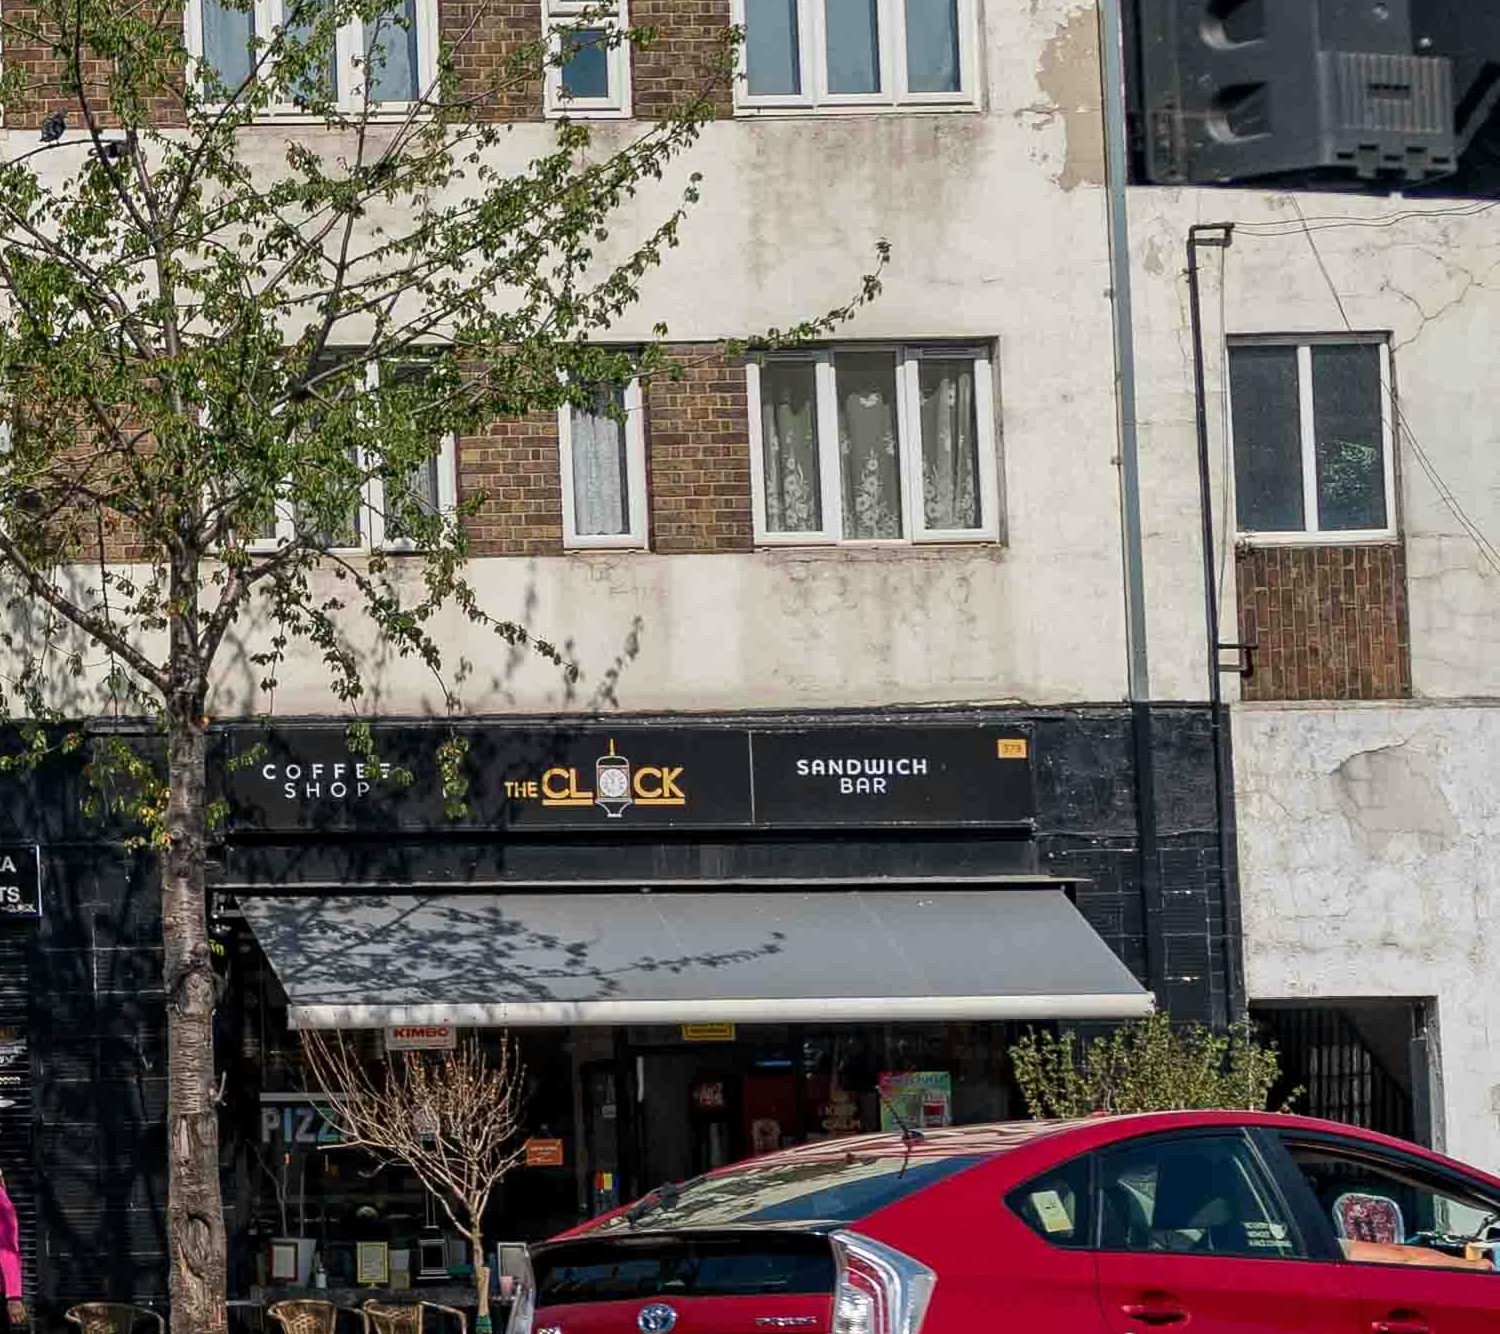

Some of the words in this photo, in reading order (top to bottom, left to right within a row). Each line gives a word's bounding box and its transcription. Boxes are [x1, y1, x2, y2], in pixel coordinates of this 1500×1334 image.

[796, 758, 927, 776] SANDWICH
[284, 781, 370, 799] SHOP
[504, 780, 538, 799] THE
[840, 777, 887, 794] BAR
